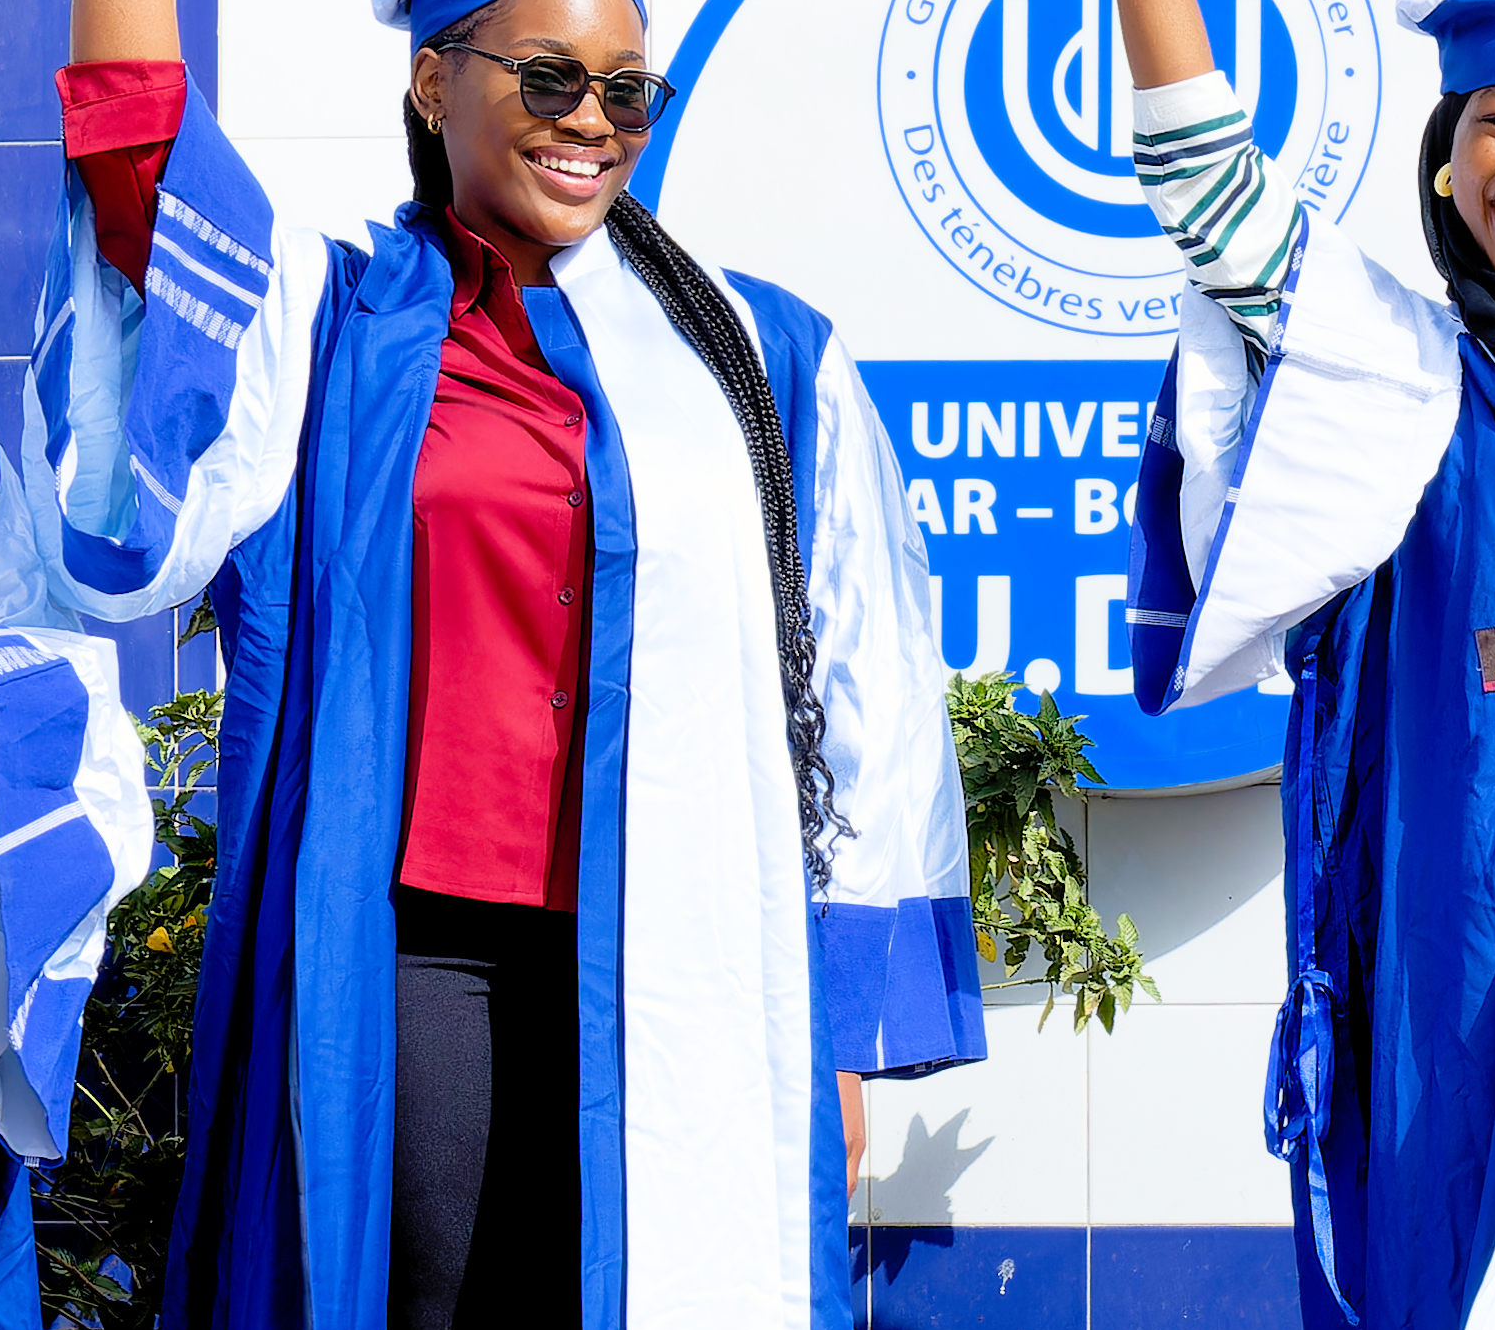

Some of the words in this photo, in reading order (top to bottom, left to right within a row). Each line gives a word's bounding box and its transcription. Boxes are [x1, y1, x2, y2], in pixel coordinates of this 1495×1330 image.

[904, 124, 945, 203] Des
[940, 207, 1103, 320] ténèbres
[1118, 292, 1182, 321] ver
[1299, 121, 1350, 212] ière
[911, 401, 1157, 459] UNIVE
[906, 478, 998, 535] AR
